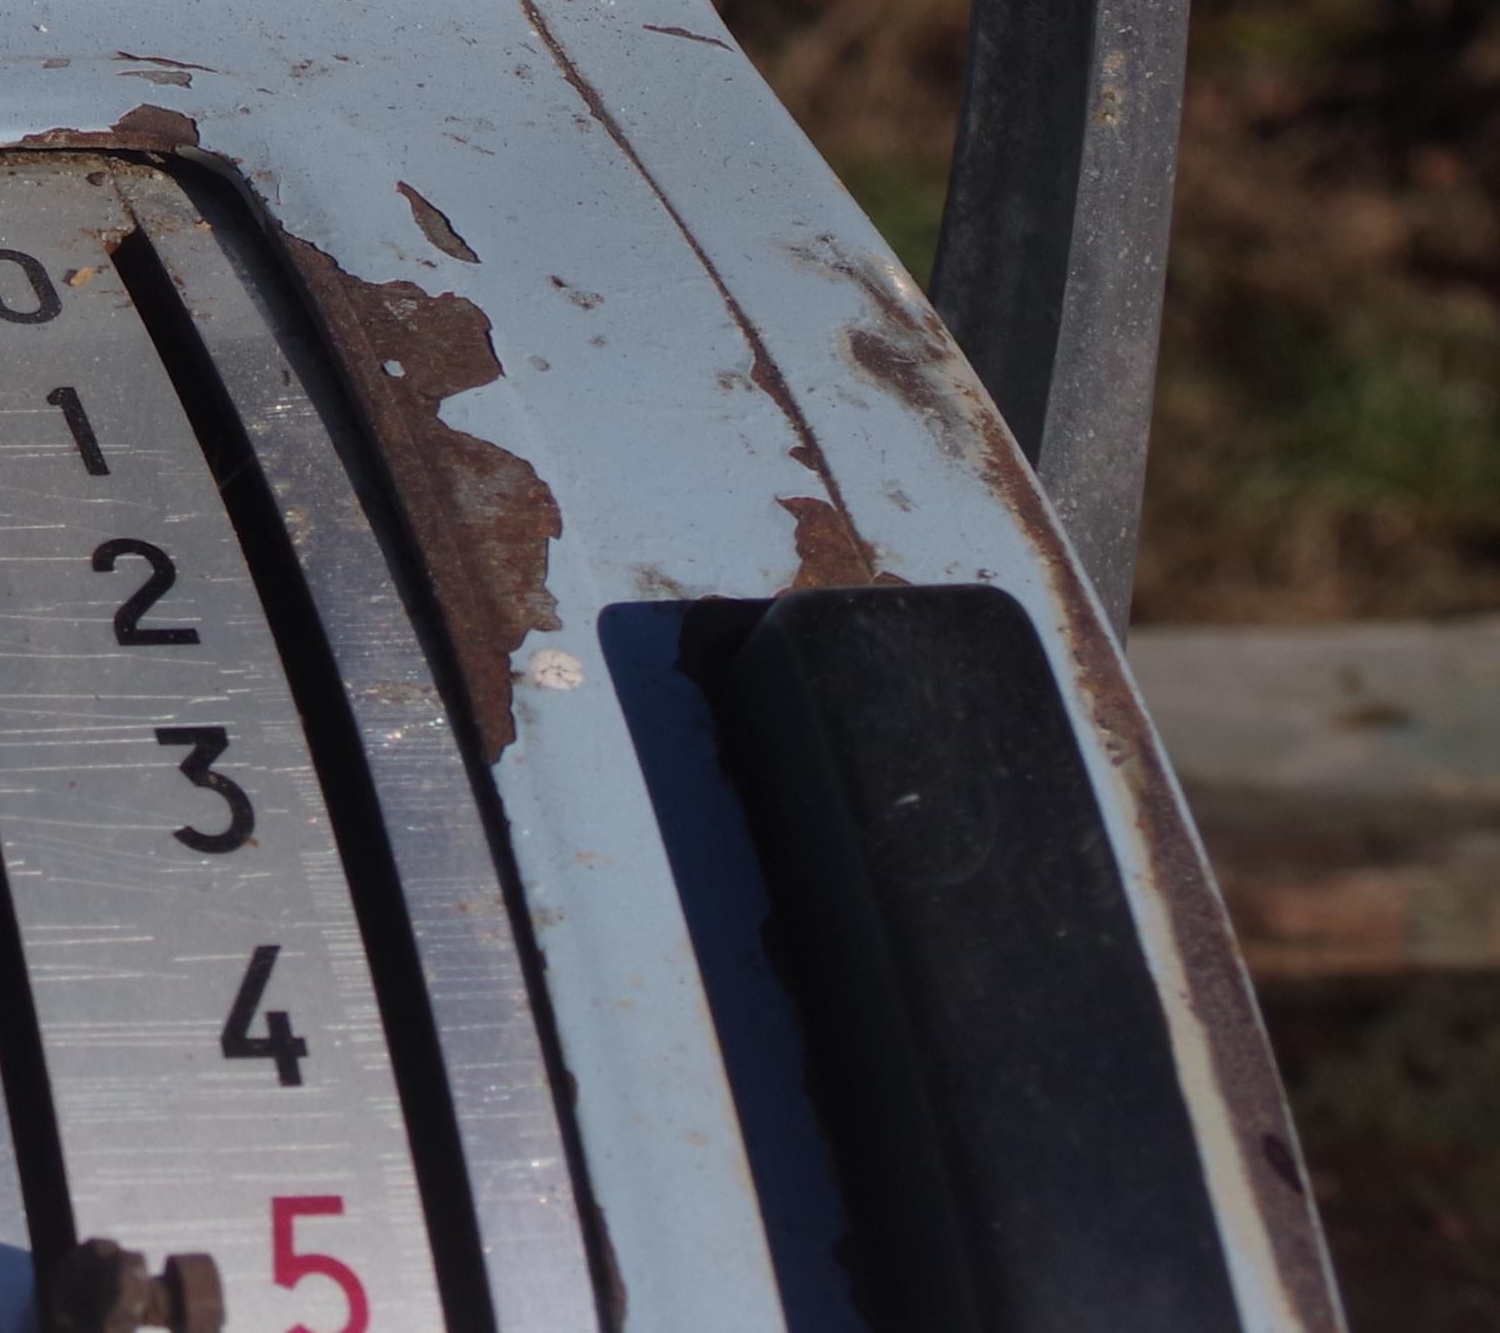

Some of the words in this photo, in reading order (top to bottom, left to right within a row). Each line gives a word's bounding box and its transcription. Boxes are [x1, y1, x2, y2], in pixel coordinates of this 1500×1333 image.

[46, 386, 110, 476] 1
[91, 538, 201, 646] 2
[154, 726, 255, 854] 3
[220, 945, 310, 1087] 4
[272, 1195, 369, 1333] 5
